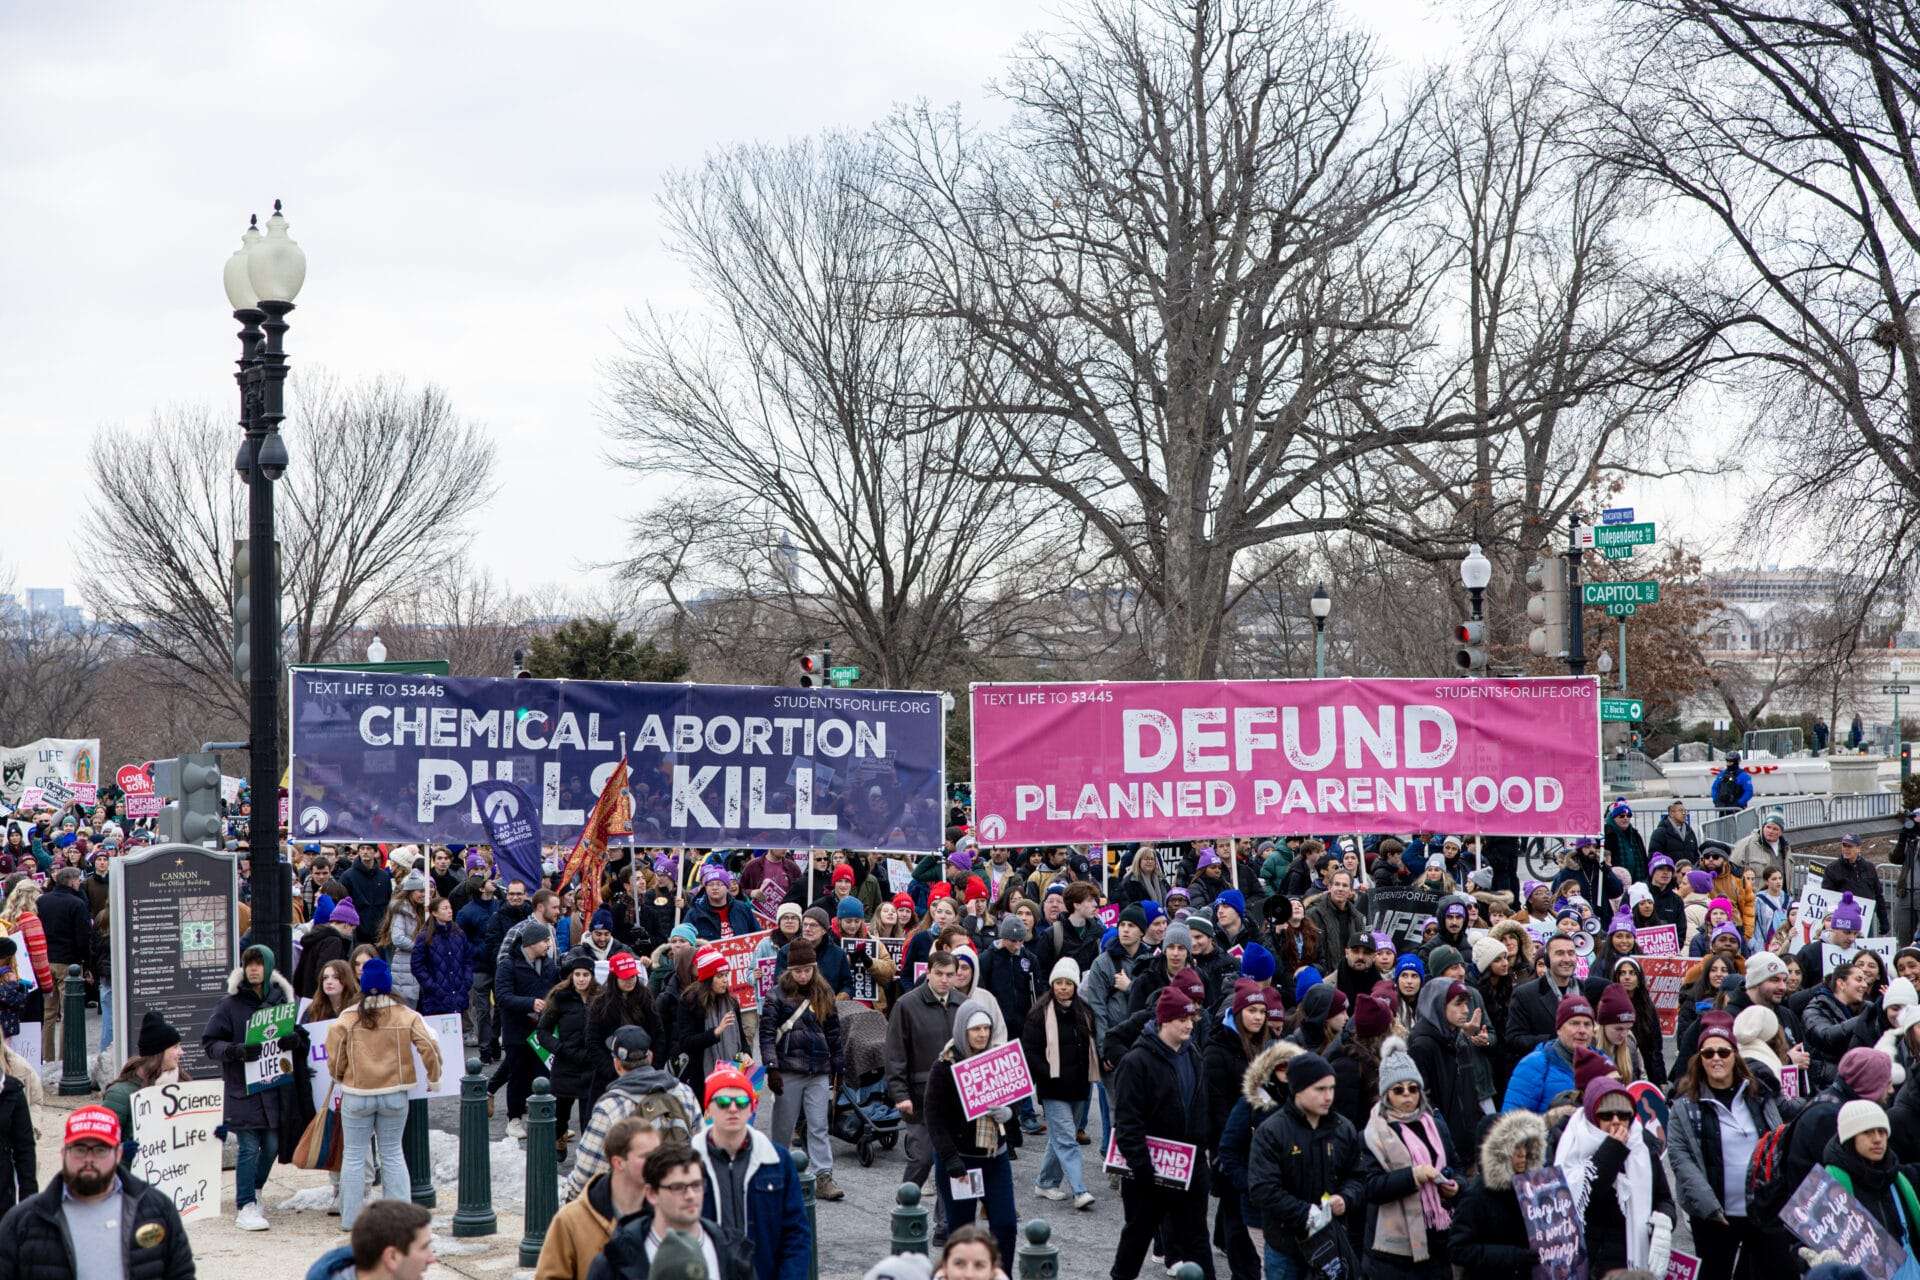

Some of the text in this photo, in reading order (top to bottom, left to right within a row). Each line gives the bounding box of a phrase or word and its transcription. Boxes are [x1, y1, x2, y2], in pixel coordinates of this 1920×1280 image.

[1598, 528, 1643, 546] Independence
[1608, 546, 1630, 558] UNIT
[1586, 585, 1643, 602] CAPITOL
[1609, 603, 1635, 614] 100
[307, 681, 444, 698] TEXT LIFE TO 53445
[982, 690, 1114, 705] TEXT LIFE TO 53445
[1434, 685, 1592, 699] STUDENTSFORLIFE.ORG
[773, 695, 931, 714] STUDENTSFORLIFE.ORG
[359, 704, 887, 758] CHEMICAL ABORTION
[1122, 704, 1458, 774] DEFUND
[38, 750, 64, 763] LIFE
[121, 774, 144, 784] LOVE
[126, 782, 150, 792] BOTH
[671, 765, 838, 830] KILL
[1015, 776, 1565, 821] PLANNED PARENTHOOD
[512, 819, 528, 828] THE
[161, 871, 198, 881] CANNON
[1636, 932, 1675, 945] EFUND
[250, 1003, 296, 1029] LOVE LIFE
[260, 1057, 279, 1078] LIFE
[960, 1051, 1021, 1088] DEFUND
[965, 1065, 1025, 1100] PLANNED
[161, 1084, 222, 1117] Science
[967, 1078, 1028, 1110] PARENTHOOD
[172, 1126, 207, 1150] Life
[145, 1160, 190, 1187] Better
[174, 1179, 208, 1213] God?
[1545, 1216, 1576, 1242] worth
[1837, 1210, 1865, 1250] worth
